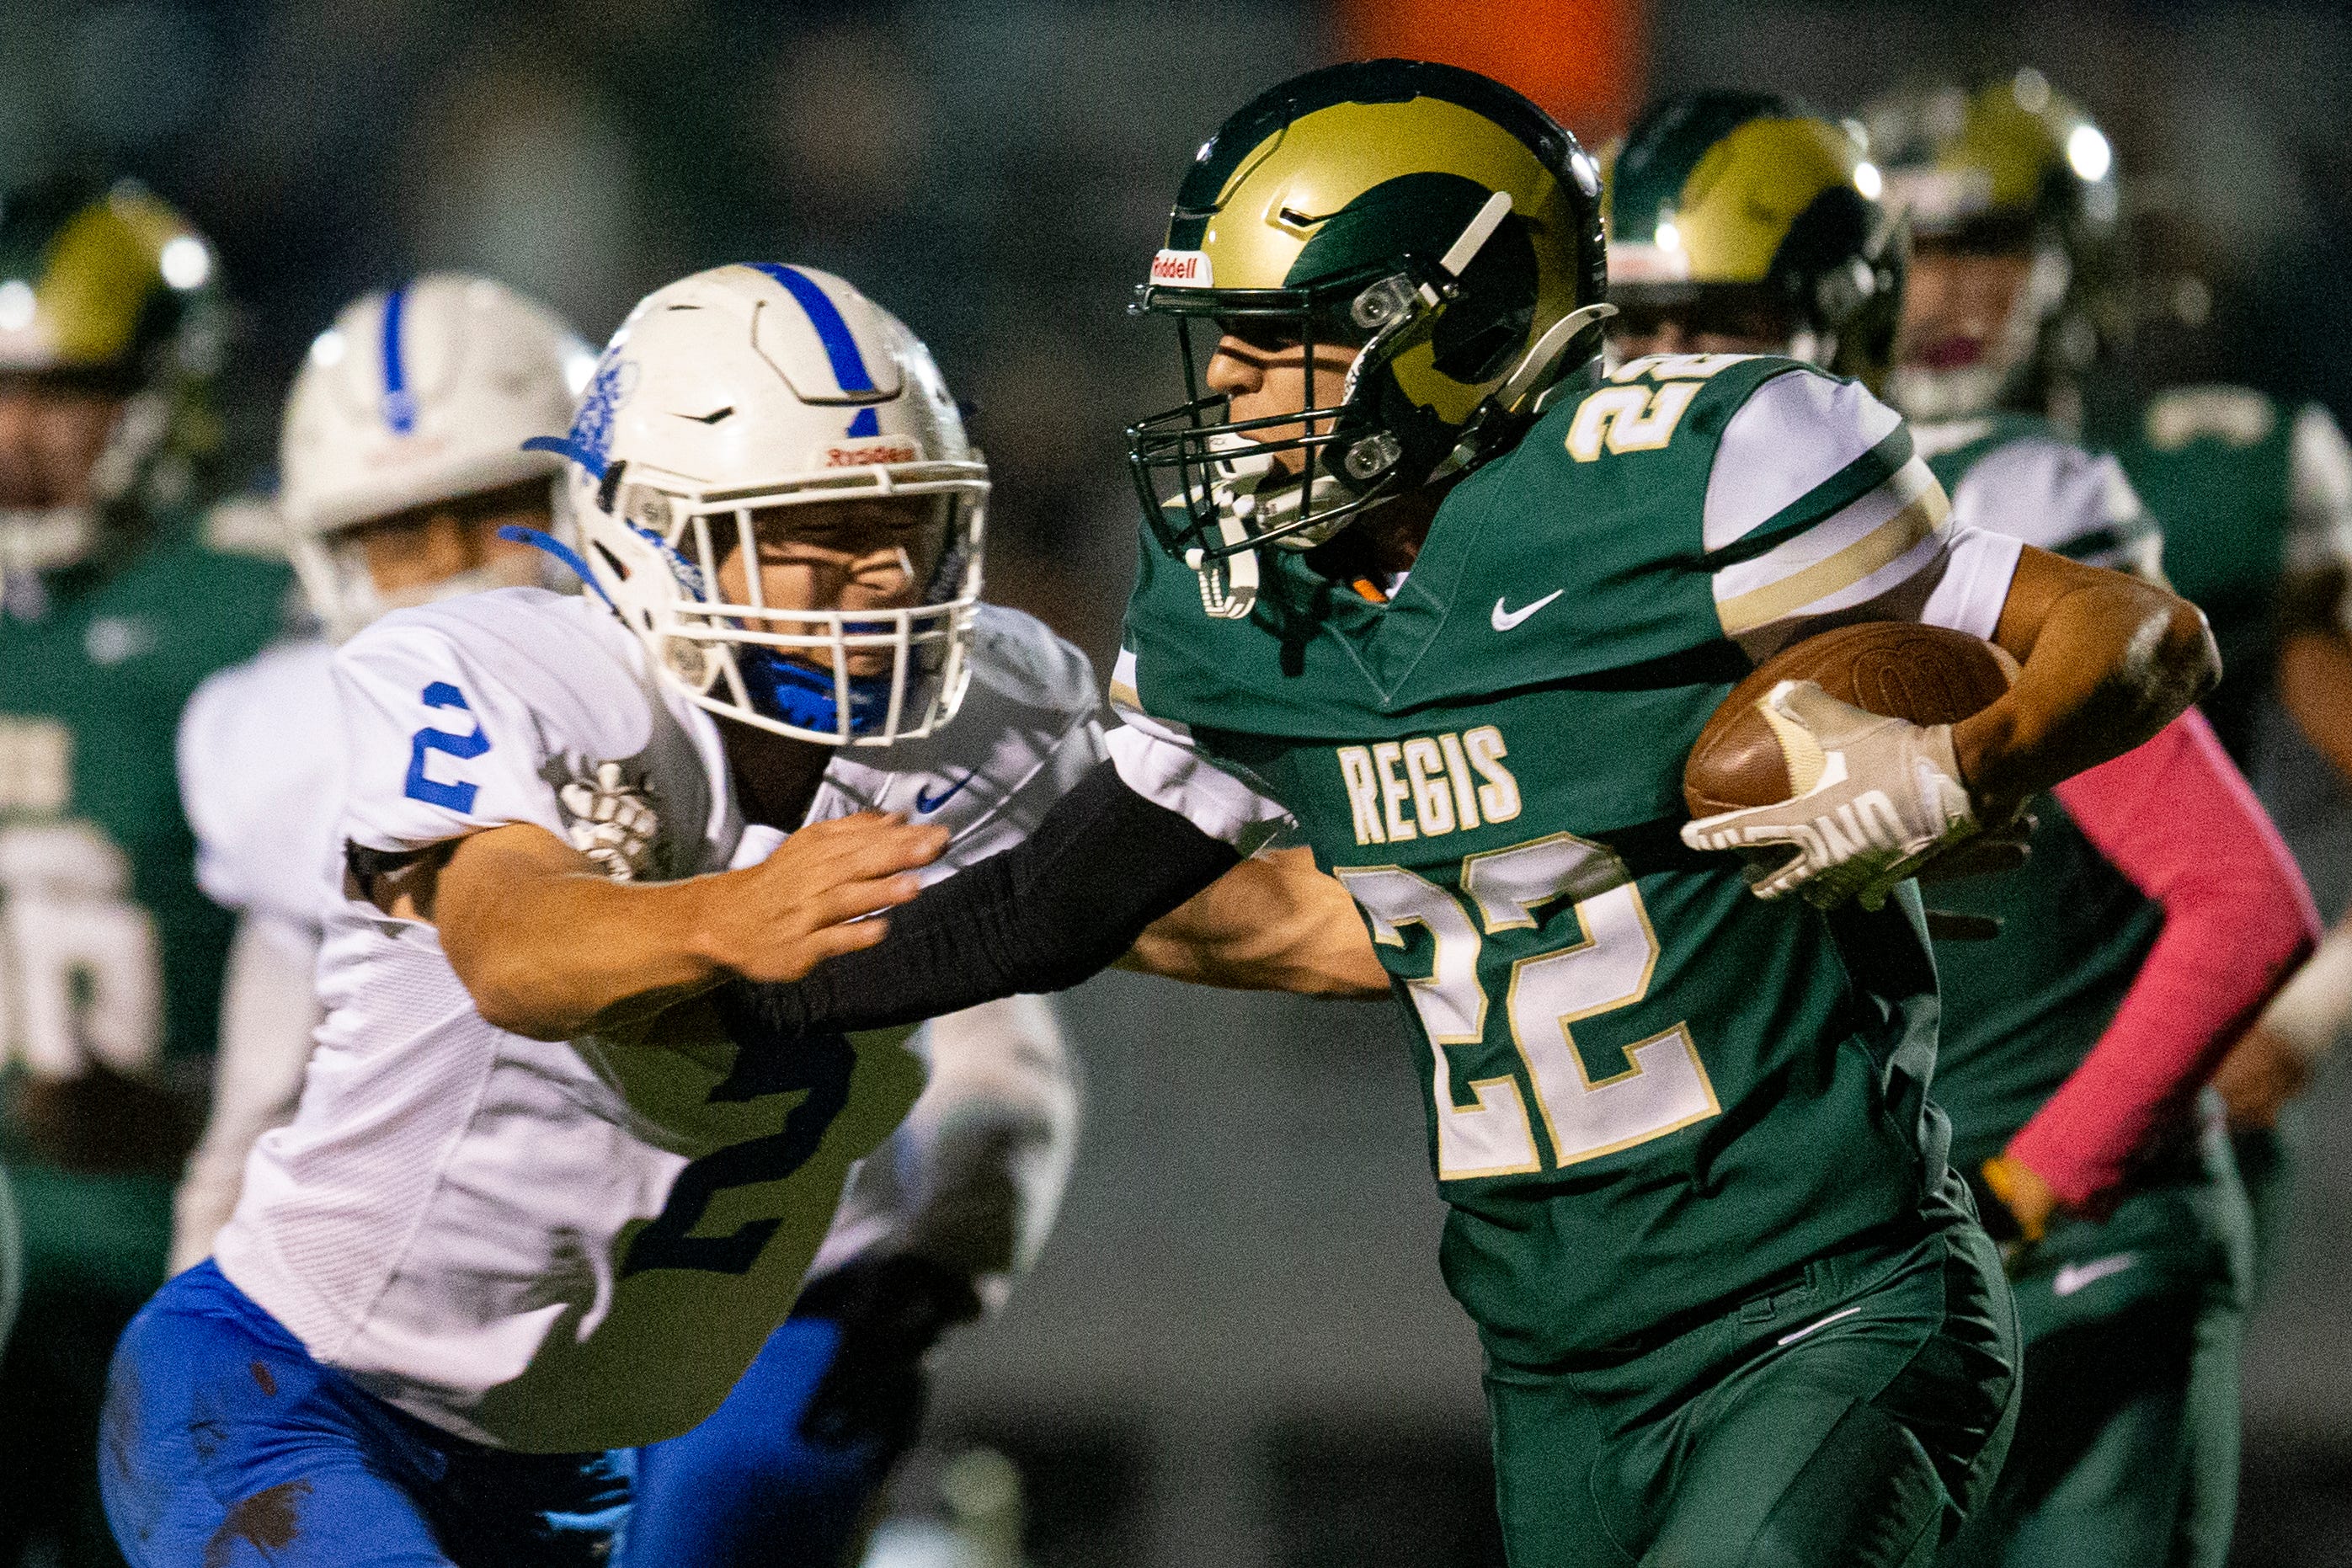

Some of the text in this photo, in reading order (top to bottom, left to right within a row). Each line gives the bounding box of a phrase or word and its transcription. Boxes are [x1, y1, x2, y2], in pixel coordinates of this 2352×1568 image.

[1565, 353, 1765, 463] 22
[404, 680, 491, 815] 2
[1336, 725, 1522, 845] REGIS
[1333, 831, 1721, 1181] 22
